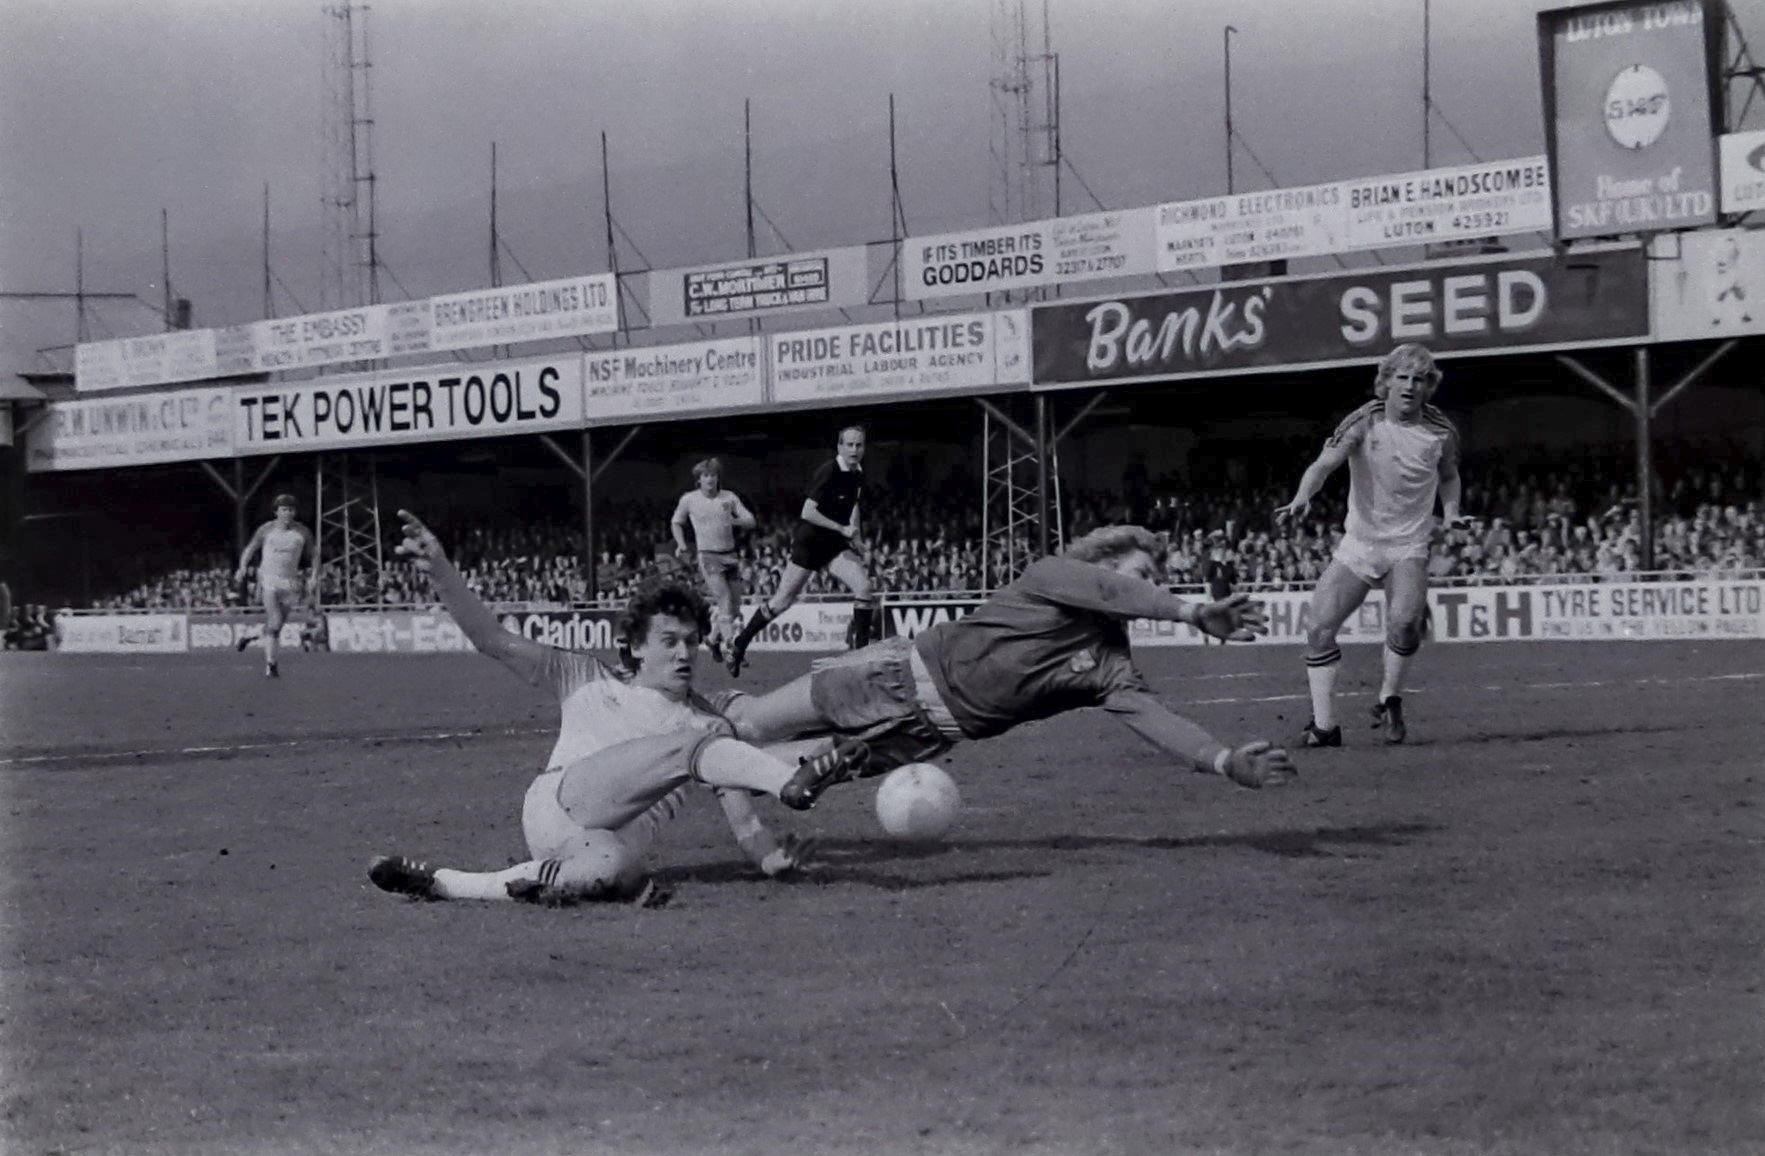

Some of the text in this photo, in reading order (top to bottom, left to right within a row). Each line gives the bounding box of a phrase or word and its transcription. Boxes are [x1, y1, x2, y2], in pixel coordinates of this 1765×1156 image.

[1239, 186, 1340, 216] ELECTRONICS
[1351, 186, 1400, 208] BRIAN
[1420, 165, 1545, 199] HANDSCOMBE
[1384, 220, 1434, 239] LUTON
[922, 233, 1044, 263] IF ITS TIMBER ITS
[922, 253, 1045, 287] GODDARDS
[512, 285, 578, 317] HOLDINGS
[1339, 269, 1548, 343] SEED
[270, 322, 297, 345] THE
[303, 314, 368, 343] EMBASSY
[777, 321, 985, 364] PRIDE FACILITIES
[624, 354, 703, 379] Machinery
[706, 349, 757, 371] Centre
[778, 362, 854, 382] INDUSTRIAL
[863, 357, 918, 374] LABOUR
[929, 351, 985, 368] AGENCY
[240, 366, 561, 441] TEK POWER TOOLS
[1541, 586, 1761, 618] TYRE SERVICE LTD
[328, 614, 477, 651] Post-Ec
[523, 612, 612, 650] Clarion
